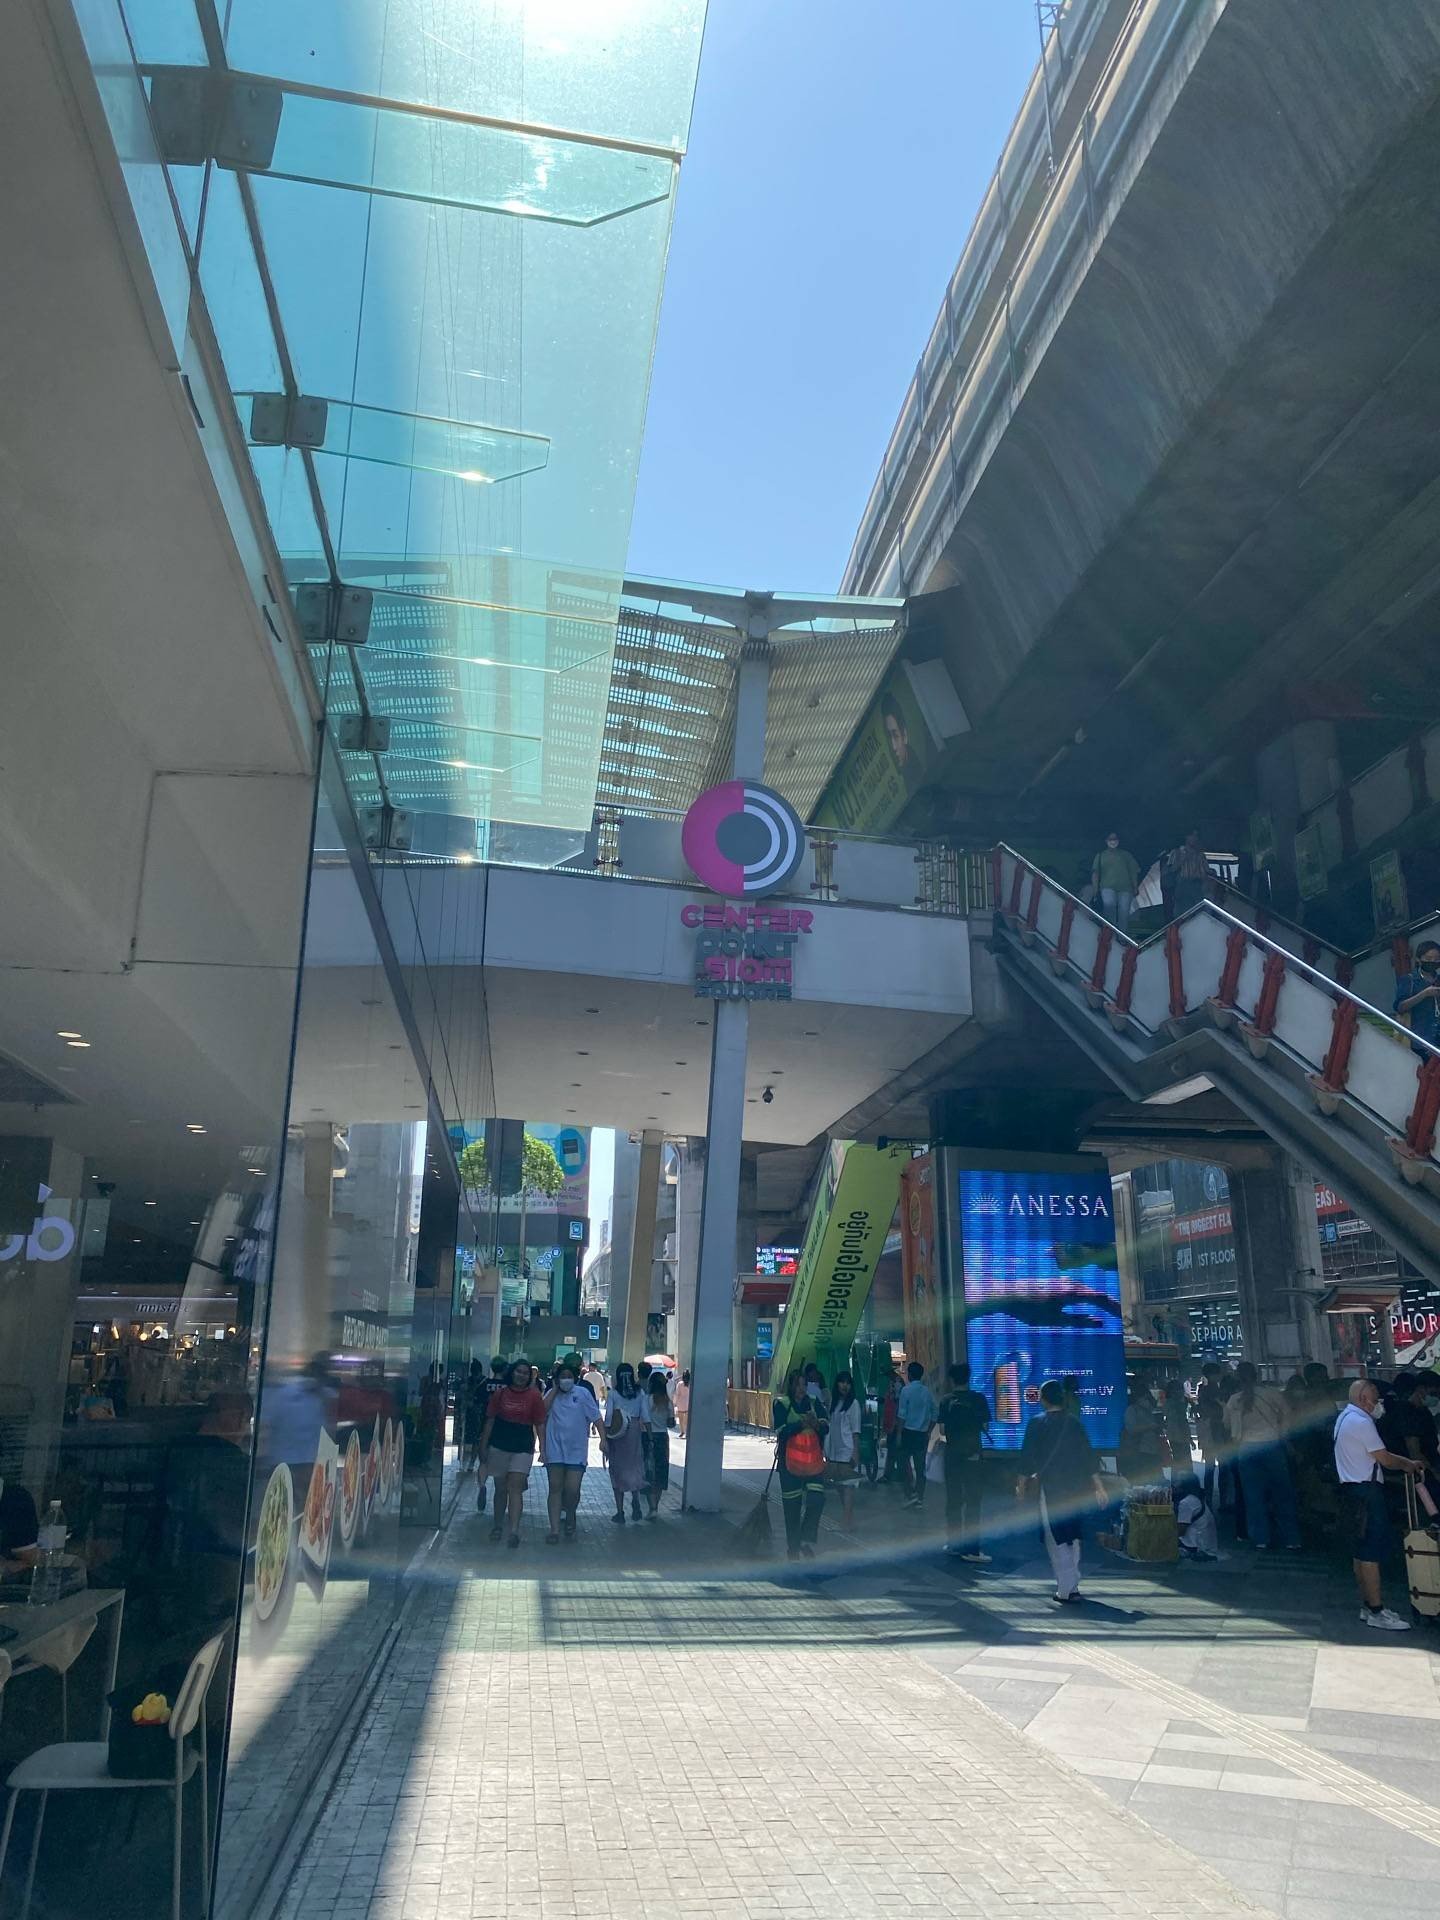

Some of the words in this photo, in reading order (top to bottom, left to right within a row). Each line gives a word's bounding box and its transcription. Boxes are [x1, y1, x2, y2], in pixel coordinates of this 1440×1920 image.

[680, 904, 814, 934] CENTER
[1008, 1193, 1109, 1217] ANESSA
[1210, 1248, 1236, 1266] FLOOR
[1191, 1325, 1243, 1343] SEPHORA
